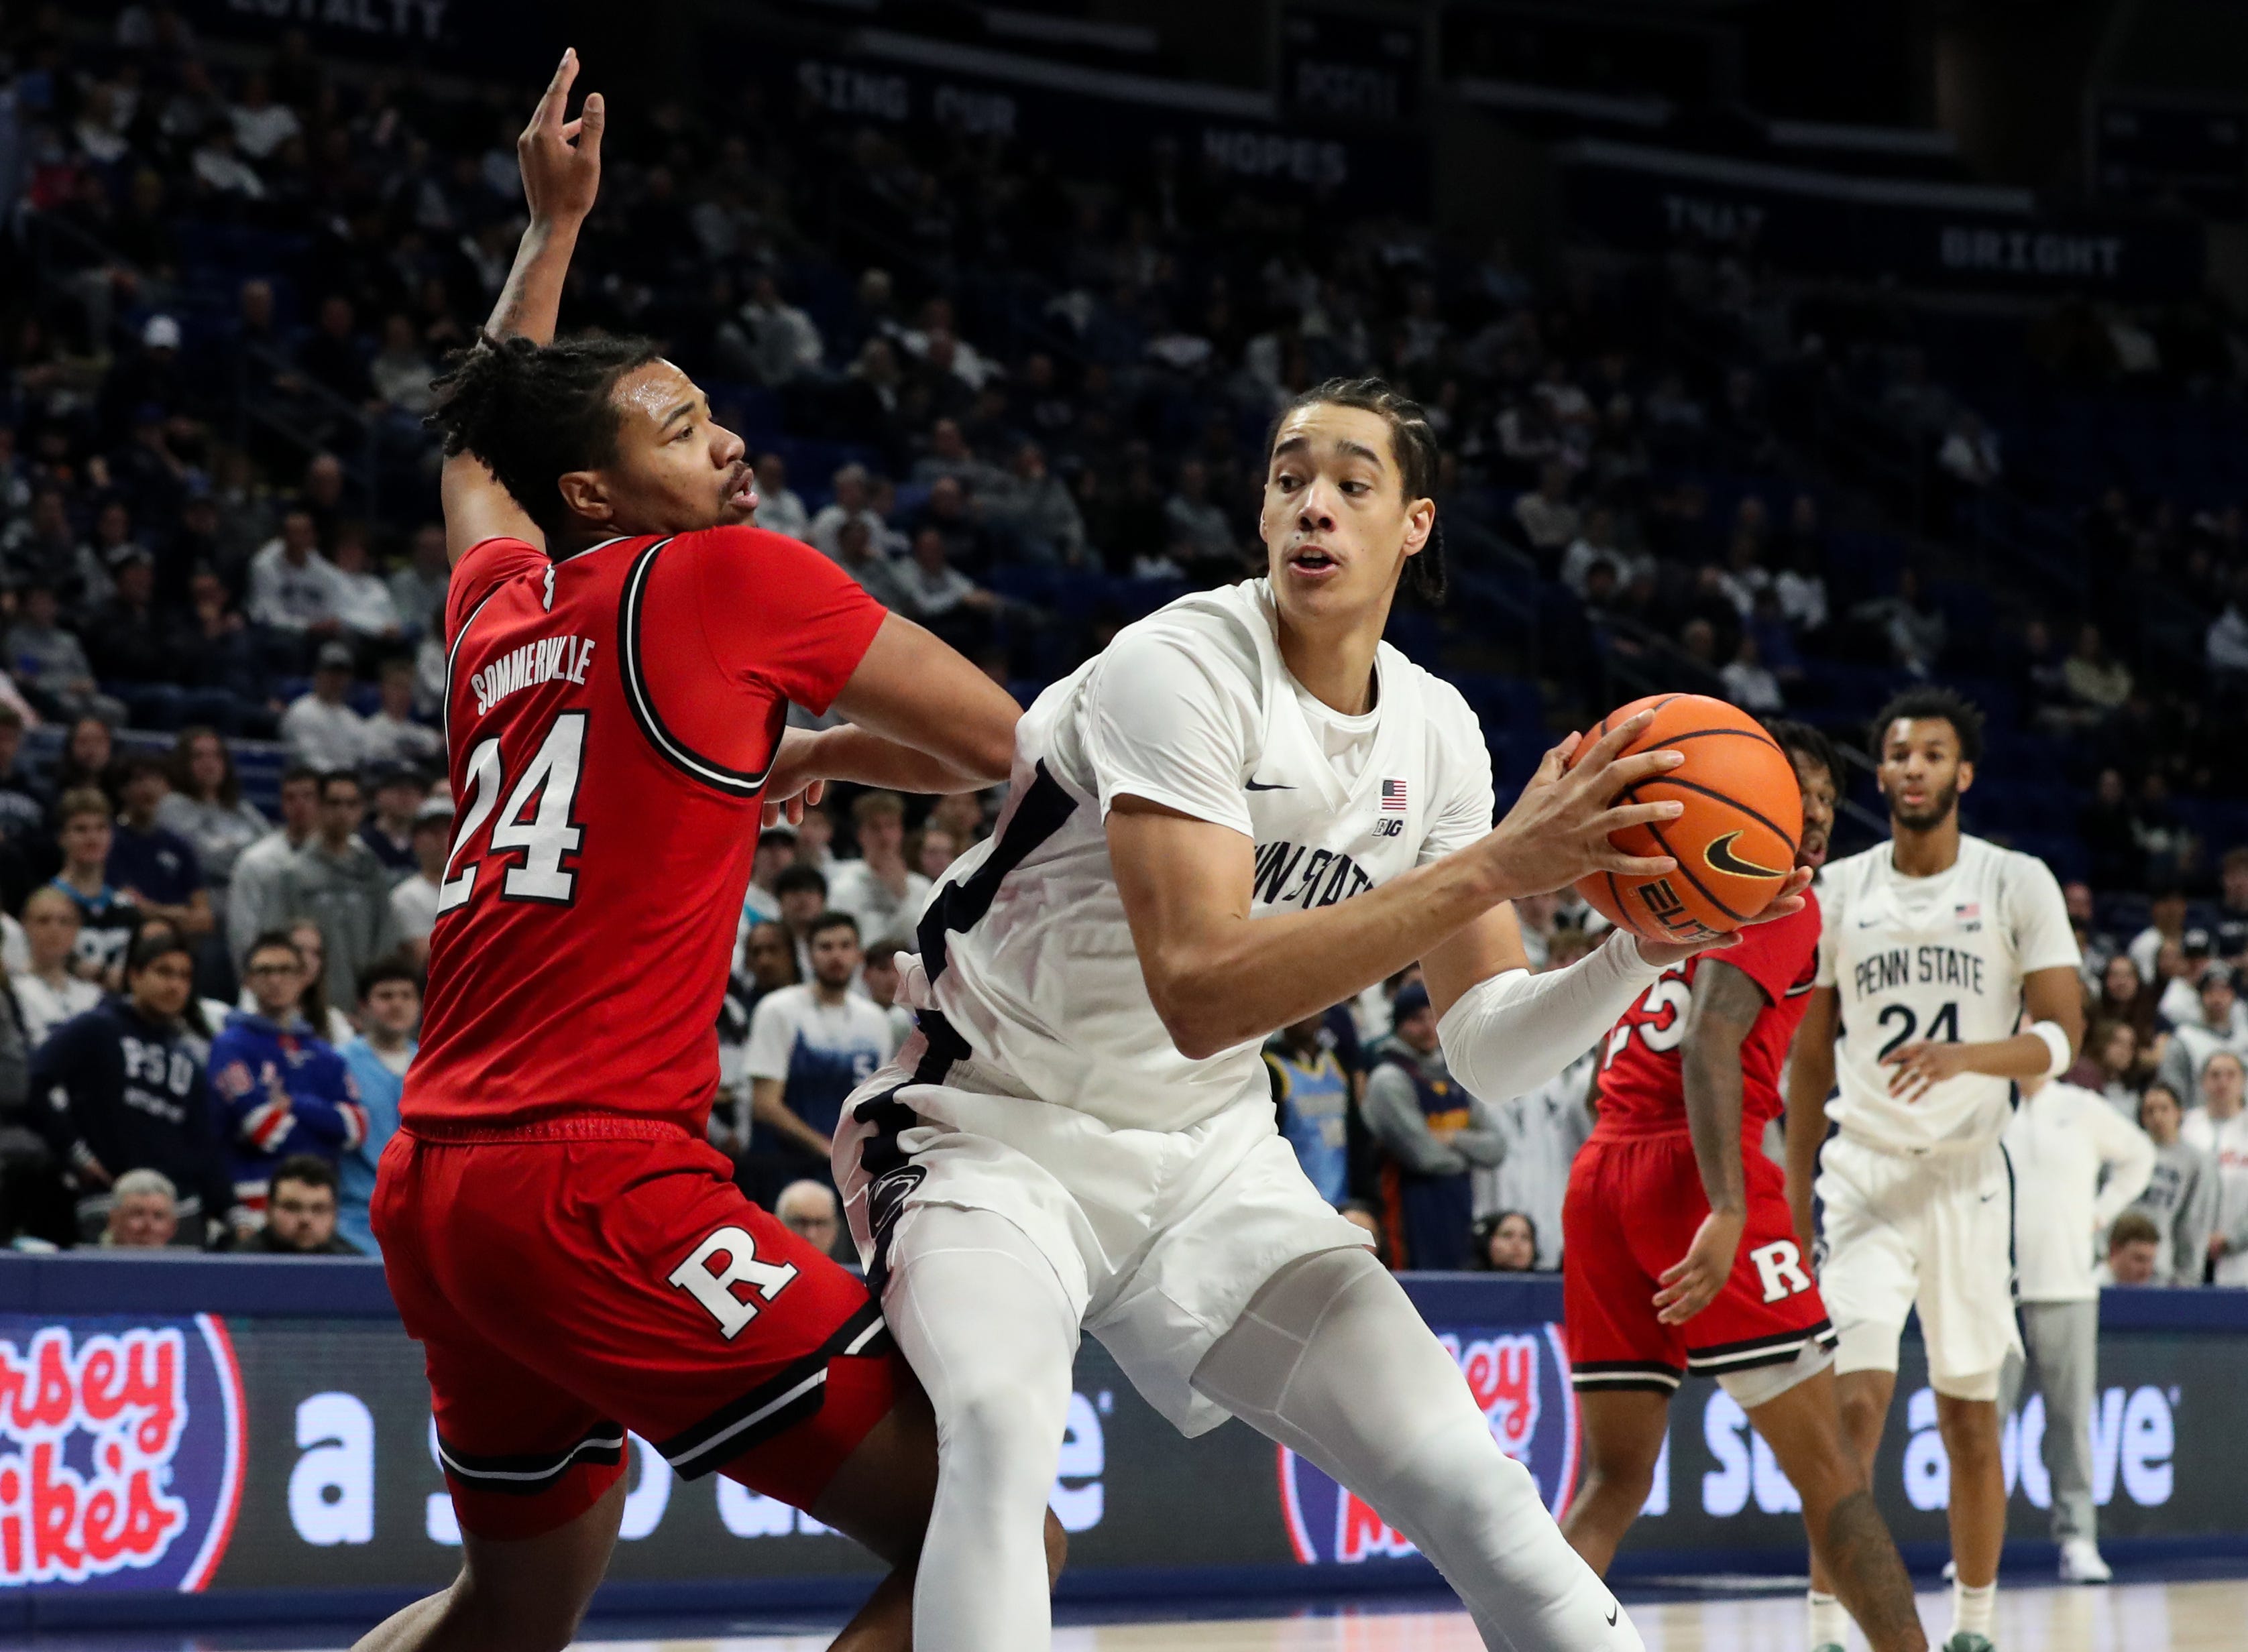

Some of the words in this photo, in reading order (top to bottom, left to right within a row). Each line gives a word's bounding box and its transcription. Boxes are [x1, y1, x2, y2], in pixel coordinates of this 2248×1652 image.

[225, 0, 451, 40] ALTY
[797, 60, 908, 121] SING
[1203, 129, 1347, 186] HOPES
[1940, 226, 2124, 278] BRIGHT
[436, 709, 590, 919] 24
[1282, 849, 1374, 909] STAT
[1855, 947, 1909, 1002] PENN
[1918, 946, 1984, 995] STATE
[1877, 1002, 1960, 1065] 24
[119, 1037, 194, 1096] PSU
[667, 1225, 799, 1340] R
[1749, 1239, 1811, 1303] R
[0, 1328, 188, 1460] rsey
[288, 1392, 374, 1545] a
[1903, 1384, 2174, 1511] aove
[0, 1441, 188, 1584] ike's
